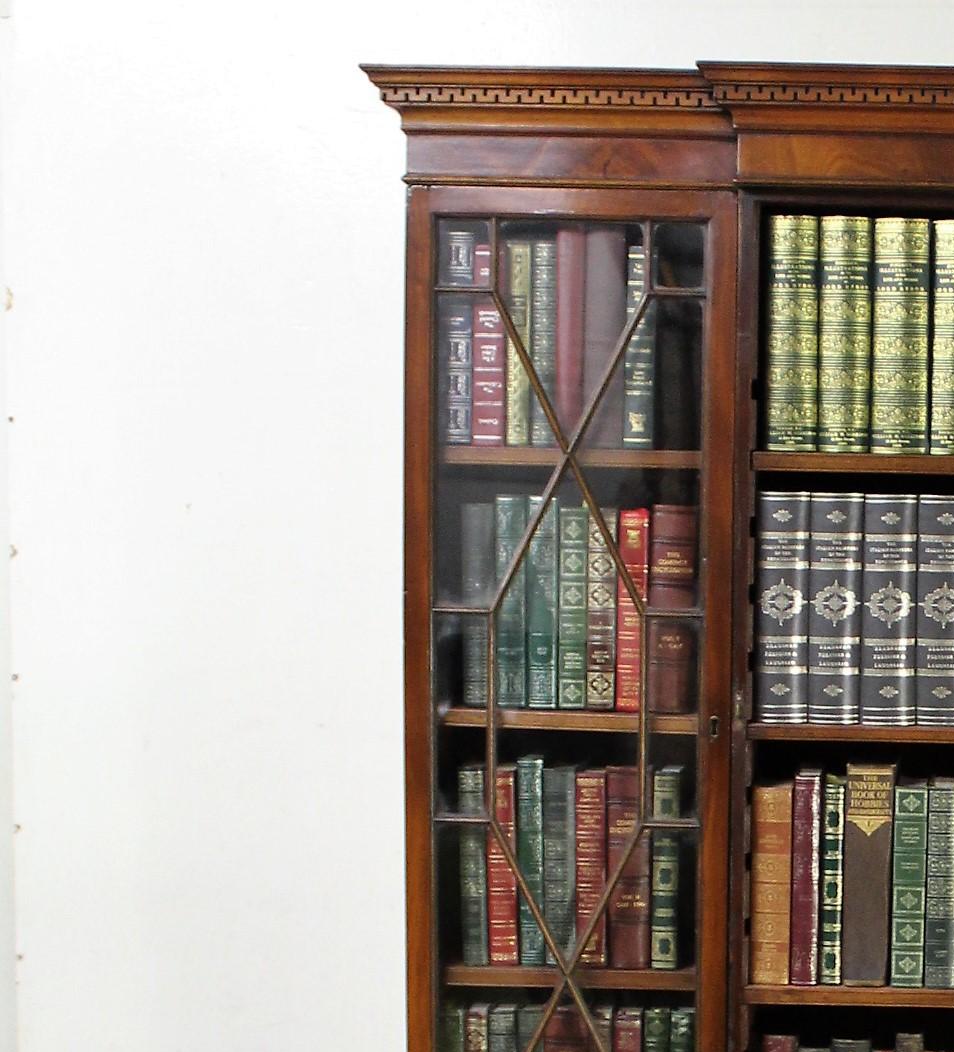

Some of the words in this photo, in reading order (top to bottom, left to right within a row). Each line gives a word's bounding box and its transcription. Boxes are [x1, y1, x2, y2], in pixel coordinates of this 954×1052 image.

[848, 781, 892, 790] UNIVERSAL
[851, 790, 876, 799] BOOK
[876, 790, 887, 799] OF
[850, 799, 889, 808] HOBBIES
